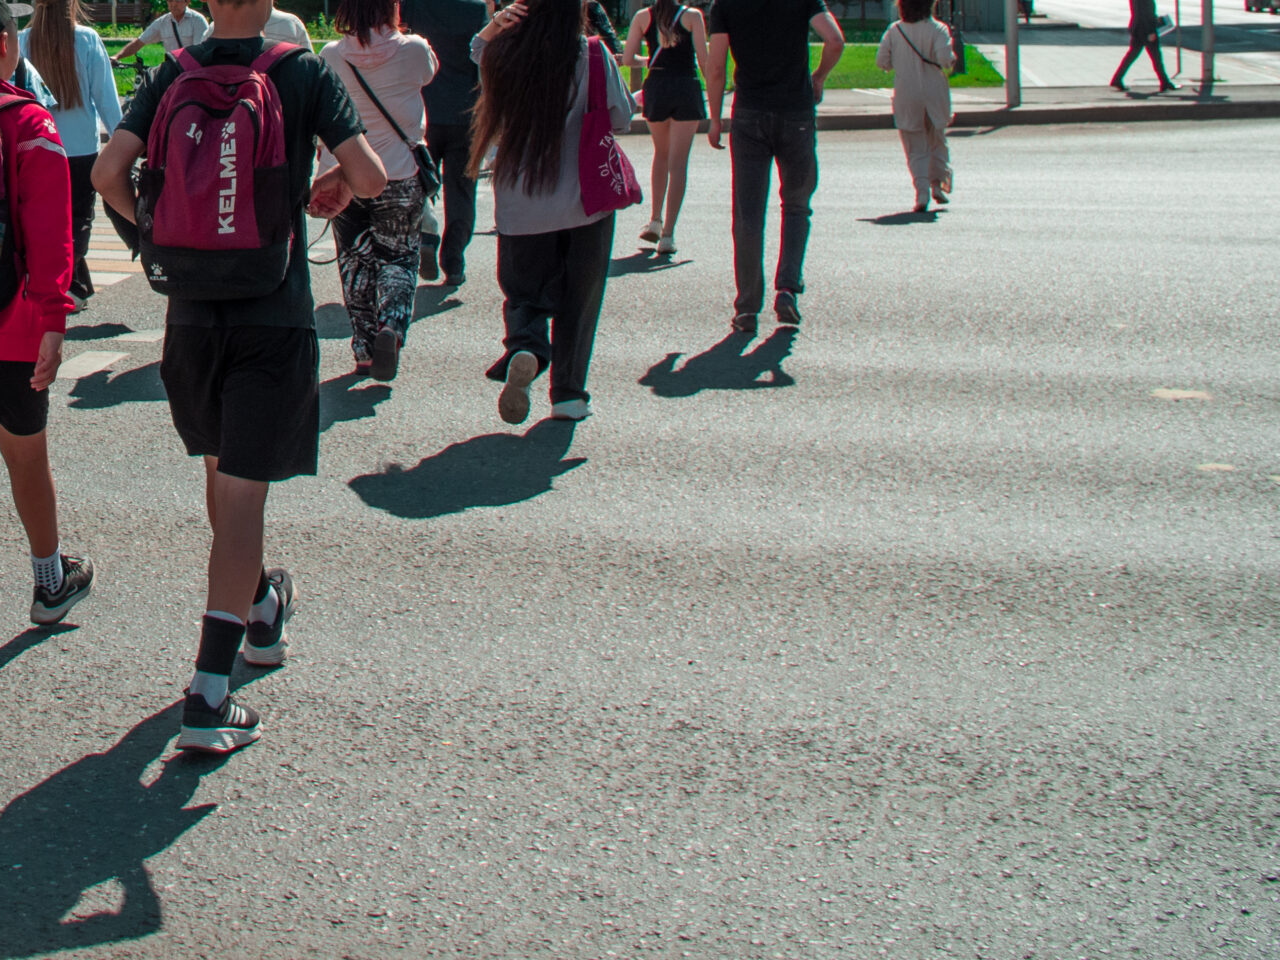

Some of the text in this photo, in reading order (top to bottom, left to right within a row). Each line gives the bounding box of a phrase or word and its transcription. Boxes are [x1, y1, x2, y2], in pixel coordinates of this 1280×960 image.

[185, 123, 203, 145] 14
[598, 162, 610, 177] TO
[217, 138, 237, 234] KELME
